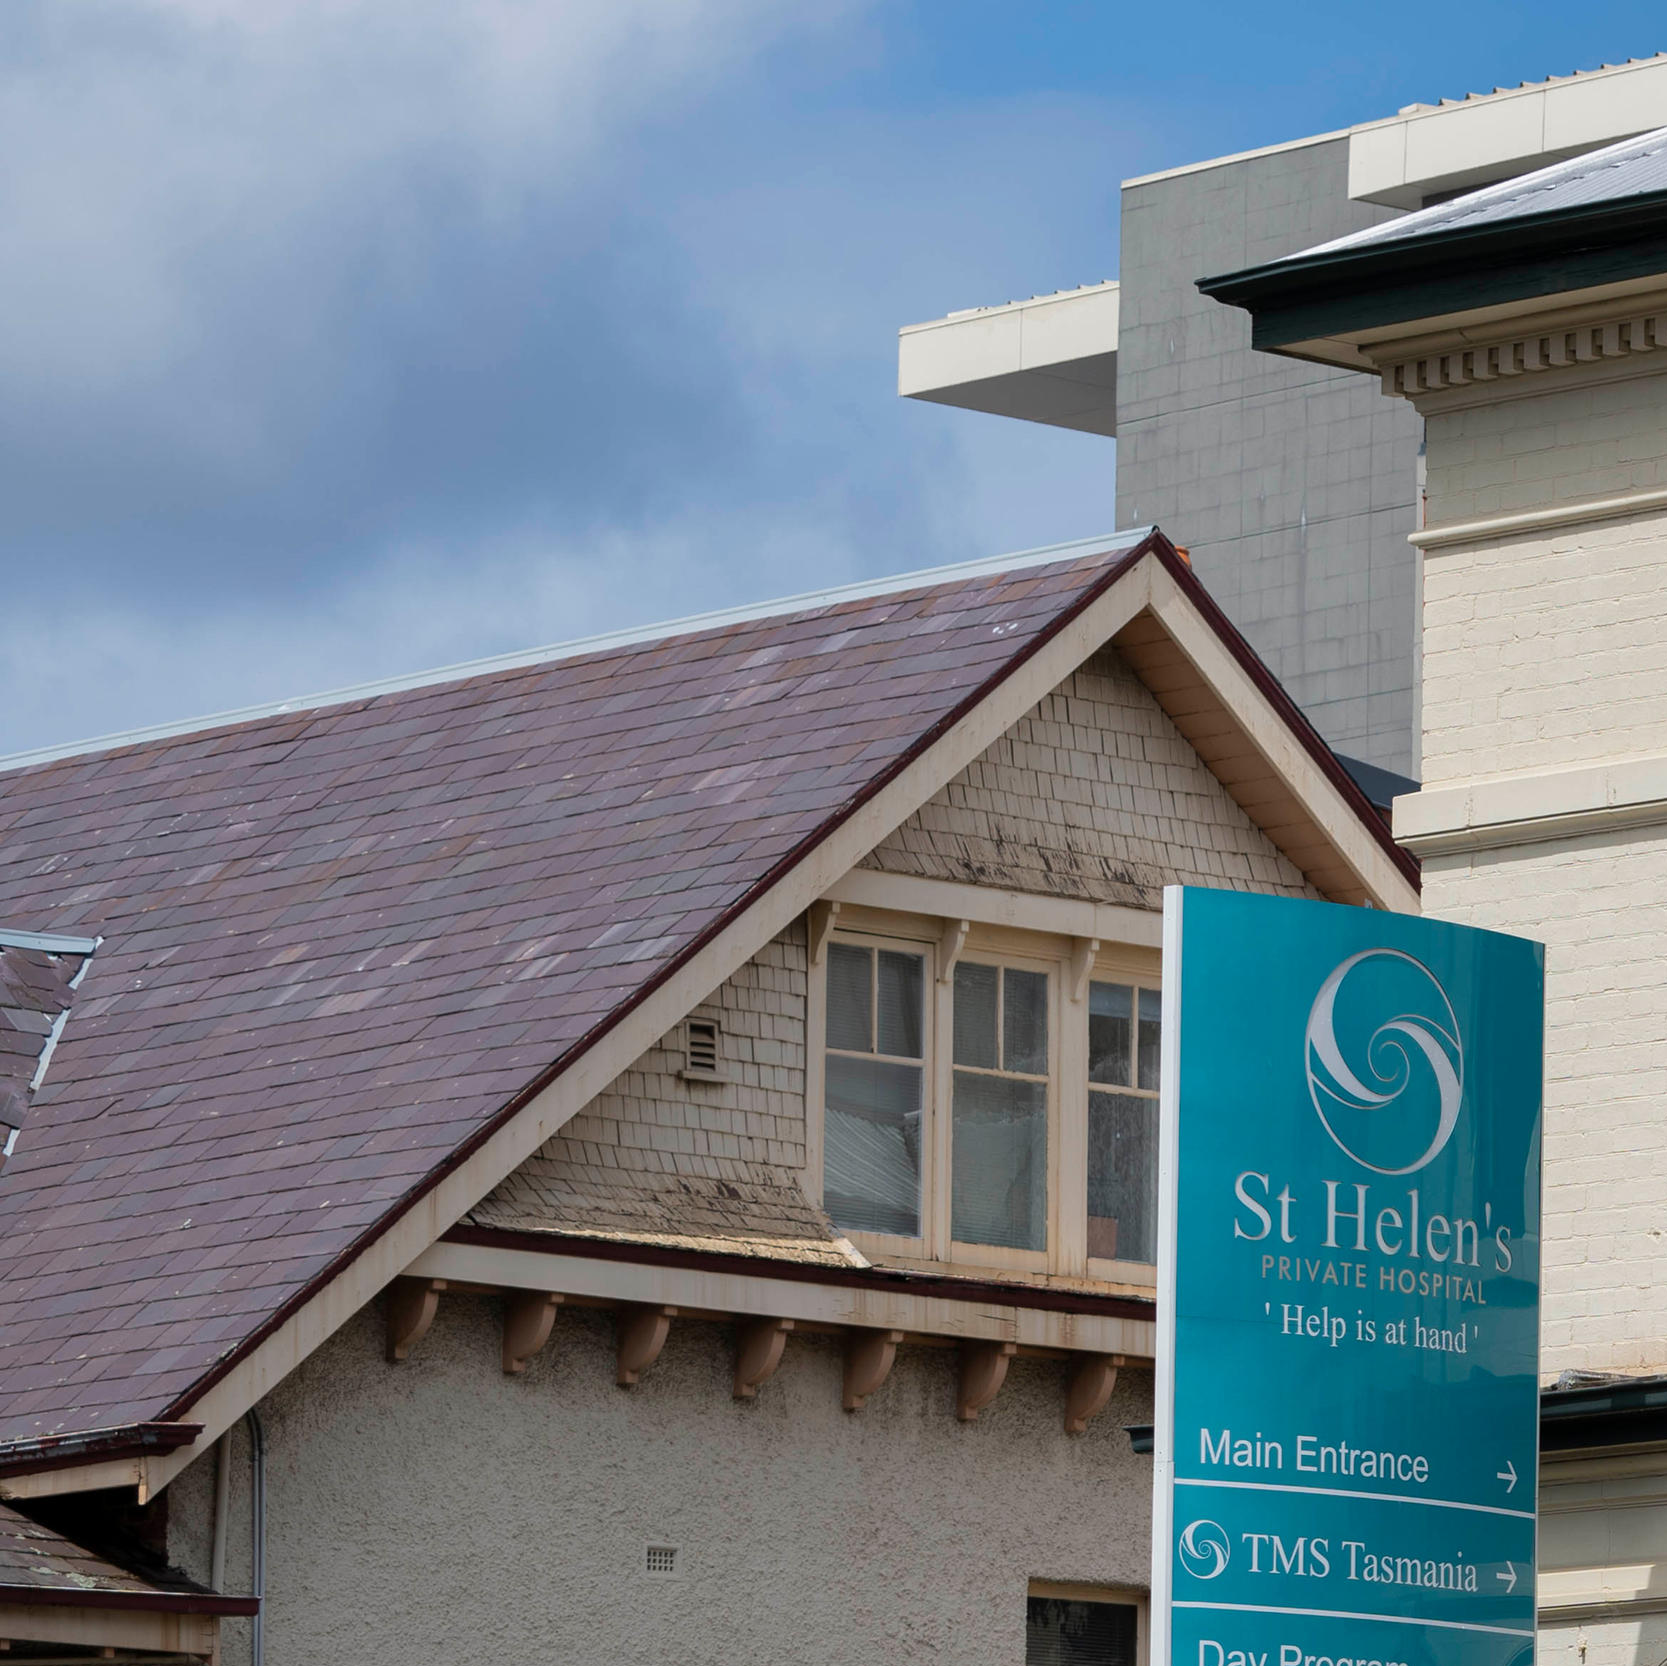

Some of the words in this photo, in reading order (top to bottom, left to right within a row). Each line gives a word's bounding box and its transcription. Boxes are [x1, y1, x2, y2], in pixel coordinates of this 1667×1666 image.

[1235, 1171, 1296, 1243] St
[1321, 1180, 1512, 1273] Helen's
[1262, 1255, 1366, 1288] PRIVATE
[1380, 1267, 1486, 1304] HOSPITAL
[1356, 1310, 1376, 1341] is
[1385, 1320, 1406, 1345] at
[1201, 1428, 1282, 1468] Main
[1297, 1436, 1428, 1482] Entrance
[1242, 1533, 1330, 1577] TMS
[1342, 1541, 1478, 1592] Tasmania
